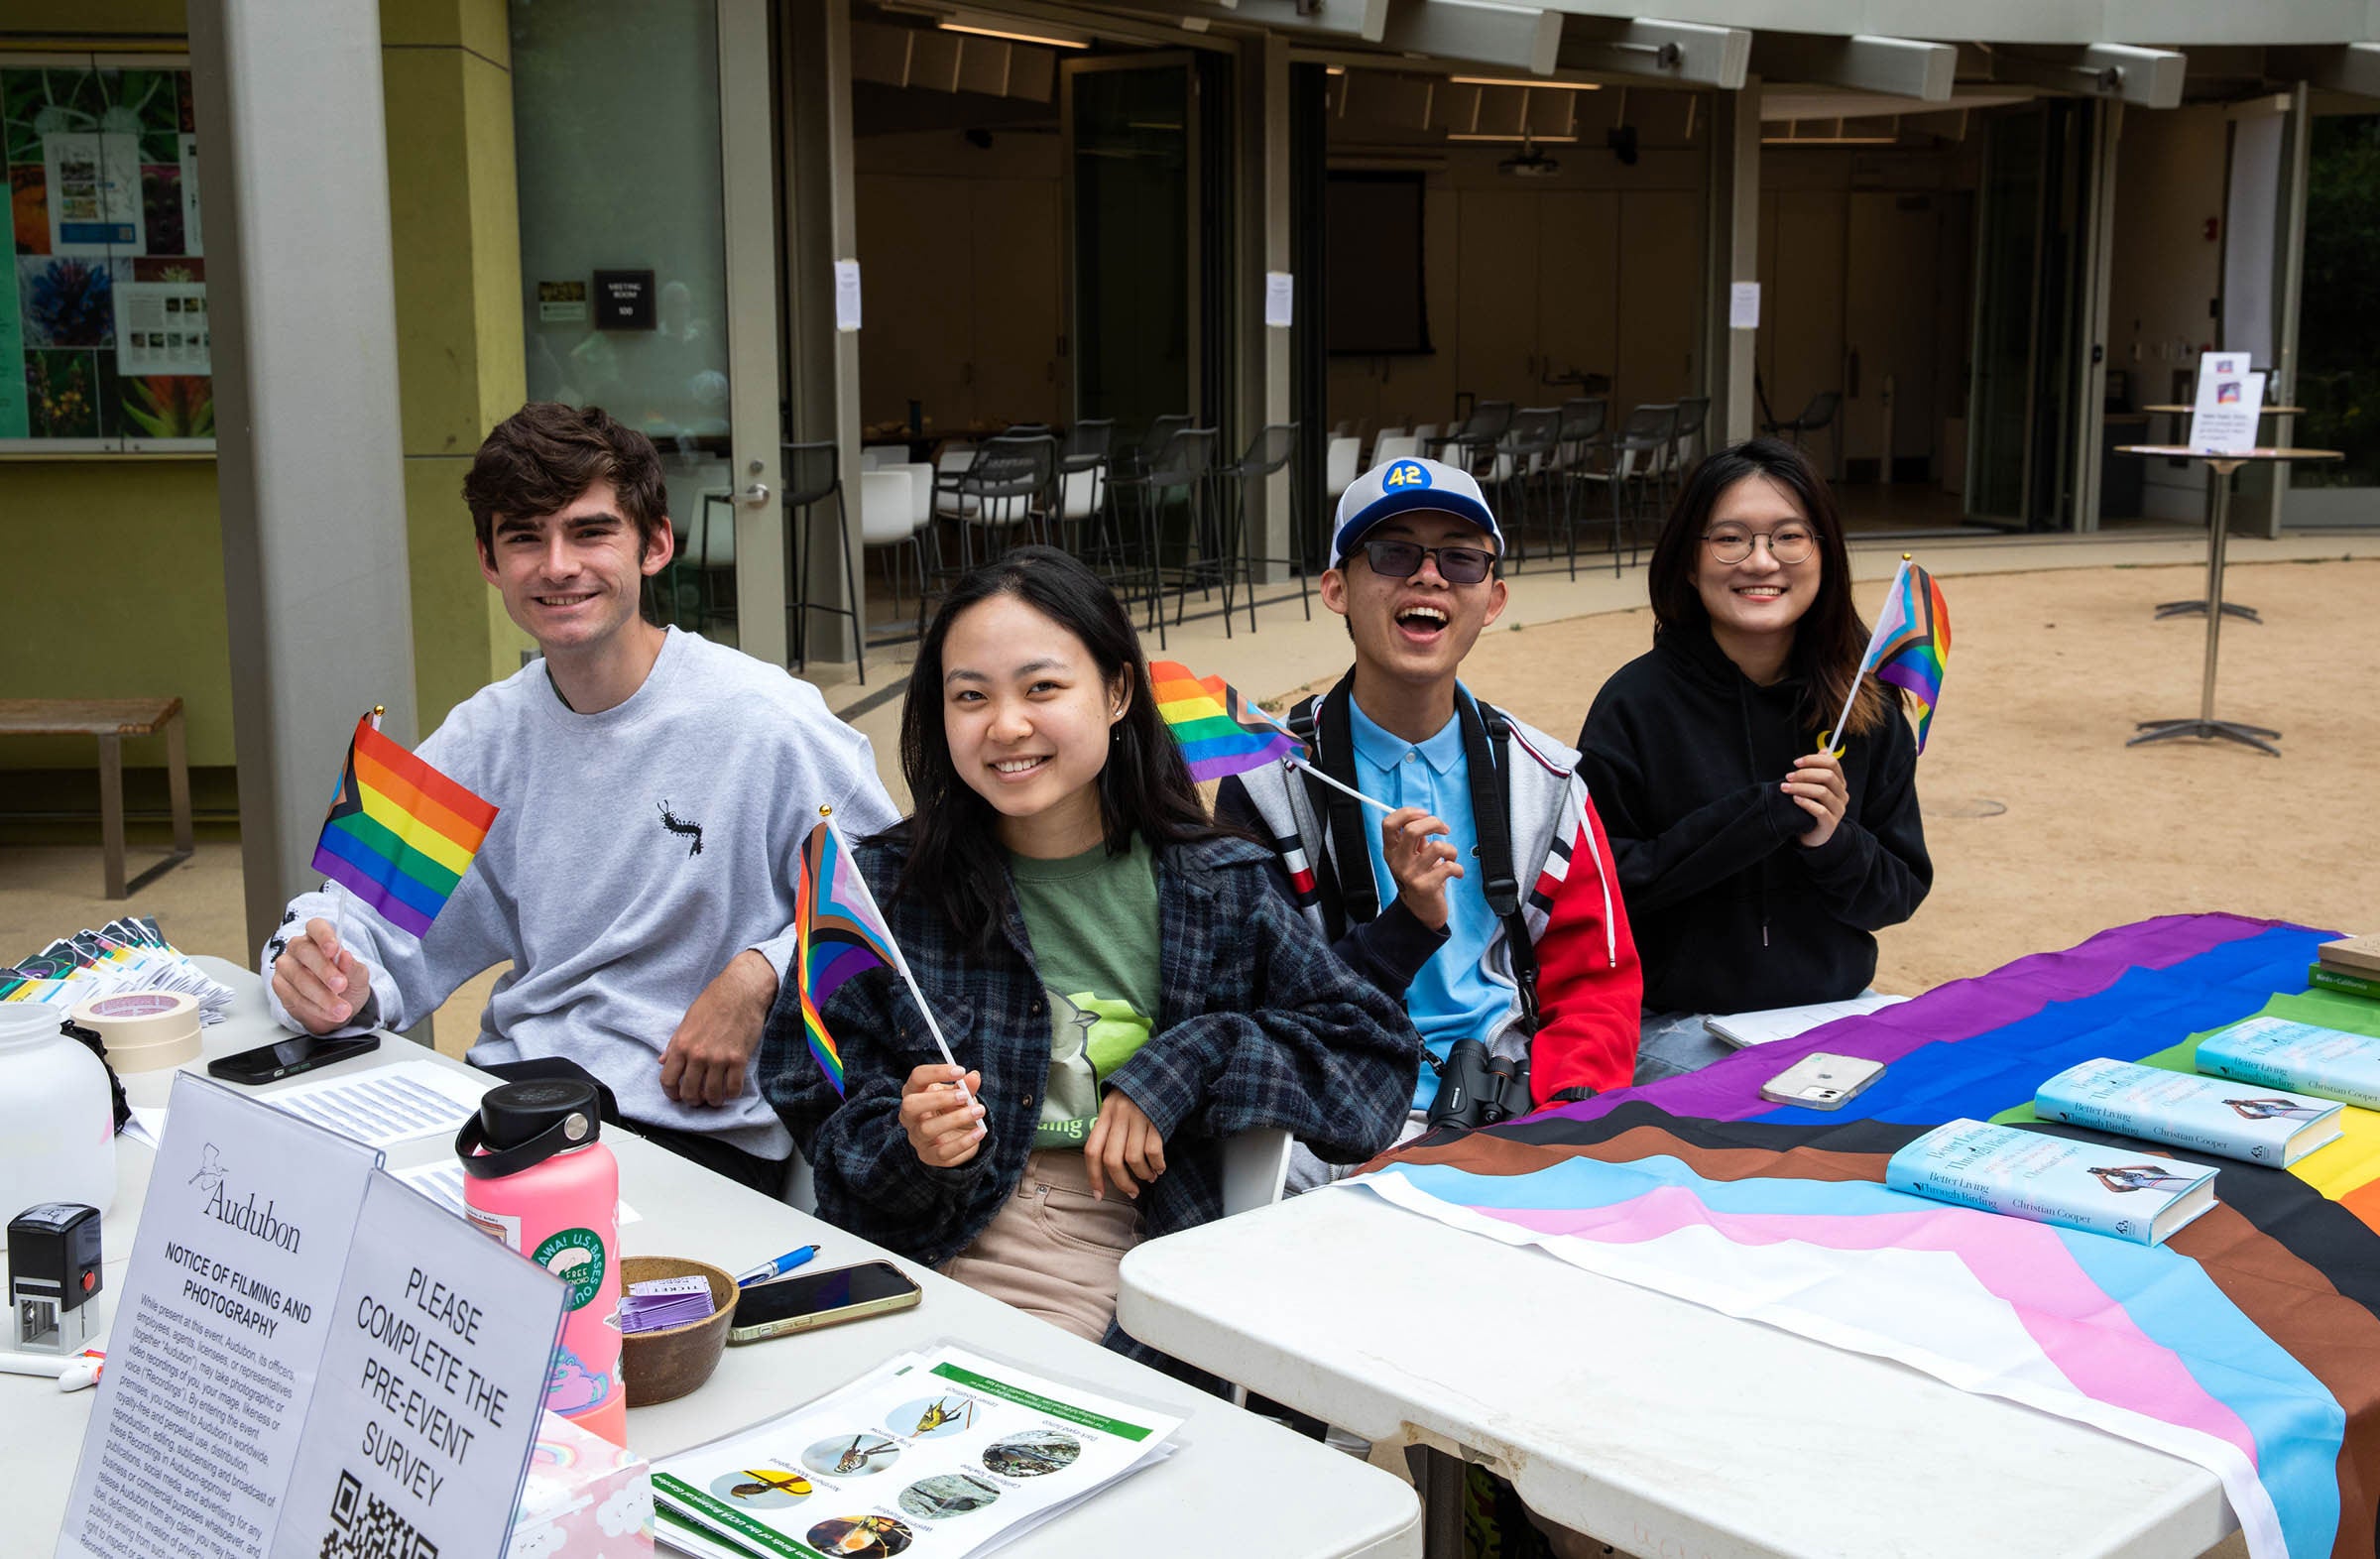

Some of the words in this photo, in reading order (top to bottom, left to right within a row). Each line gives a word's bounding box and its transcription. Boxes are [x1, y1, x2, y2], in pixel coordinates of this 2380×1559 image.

[1388, 466, 1422, 486] 42
[2317, 974, 2332, 983] Birds
[2234, 1057, 2260, 1070] Better
[2261, 1063, 2289, 1076] Living
[2227, 1067, 2262, 1082] Through
[2263, 1075, 2296, 1090] Birding
[2309, 1080, 2346, 1095] Christian
[2347, 1087, 2380, 1102] Cooper
[2075, 1102, 2101, 1117] Better
[2102, 1109, 2132, 1123] Living
[2067, 1112, 2104, 1128] Through
[2105, 1121, 2139, 1136] Birding
[2153, 1127, 2194, 1142] Christian
[2195, 1135, 2228, 1149] Cooper
[1930, 1171, 1958, 1187] Better
[1959, 1179, 1990, 1194] Living
[203, 1179, 301, 1254] Audubon
[1920, 1182, 1961, 1200] Through
[1962, 1192, 1998, 1209] Birding
[2012, 1198, 2056, 1216] Christian
[2057, 1207, 2091, 1224] Cooper
[565, 1267, 588, 1279] FREE
[590, 1244, 602, 1285] BASES
[165, 1241, 210, 1276] NOTICE
[211, 1262, 230, 1282] OF
[229, 1271, 281, 1309] FILMING
[282, 1291, 312, 1324] AND
[182, 1279, 279, 1339] PHOTOGRAPHY
[405, 1266, 483, 1346] PLEASE
[140, 1292, 158, 1311] While
[158, 1304, 183, 1323] present
[182, 1316, 191, 1328] at
[190, 1319, 203, 1334] this
[258, 1353, 267, 1366] its
[131, 1325, 161, 1349] (together
[199, 1362, 214, 1380] may
[213, 1369, 229, 1385] take
[229, 1378, 275, 1409] photographic
[275, 1401, 285, 1414] or
[357, 1295, 463, 1394] COMPLETE
[464, 1368, 509, 1429] THE
[128, 1343, 146, 1360] video
[145, 1352, 178, 1379] recordings
[178, 1370, 187, 1381] of
[200, 1382, 218, 1398] your
[241, 1401, 271, 1426] likeness
[271, 1419, 280, 1431] or
[230, 1360, 238, 1371] or
[238, 1364, 293, 1399] representatives
[945, 1386, 978, 1400] Goldfinch
[115, 1390, 151, 1417] royalty-free
[150, 1410, 165, 1424] and
[164, 1418, 195, 1442] perpetual
[123, 1359, 141, 1375] voice
[188, 1392, 198, 1409] By
[198, 1399, 226, 1424] entering
[225, 1413, 238, 1428] the
[238, 1421, 260, 1440] event
[149, 1391, 163, 1406] you
[163, 1398, 189, 1421] consent
[188, 1412, 196, 1425] to
[361, 1357, 475, 1466] PRE-EVENT
[977, 1396, 999, 1408] Lesser
[870, 1427, 895, 1441] Sparrow
[1042, 1419, 1066, 1431] Junco
[1062, 1425, 1099, 1442] Dark-eyed
[108, 1422, 127, 1441] these
[126, 1431, 161, 1462] Recordings
[161, 1453, 169, 1466] in
[177, 1444, 217, 1478] sublicensing
[216, 1468, 231, 1483] and
[230, 1474, 268, 1504] broadcast
[266, 1497, 276, 1508] of
[361, 1420, 444, 1506] SURVEY
[769, 1458, 811, 1480] Mockingbird
[960, 1464, 987, 1478] Towhee
[653, 1475, 682, 1493] Garden
[810, 1475, 841, 1493] Northern
[990, 1475, 1021, 1490] California
[97, 1472, 120, 1493] release
[119, 1484, 149, 1510] Audubon
[148, 1501, 165, 1520] from
[164, 1512, 176, 1530] any
[176, 1520, 194, 1539] claim
[194, 1532, 209, 1548] you
[209, 1541, 224, 1559] may
[101, 1454, 127, 1479] business
[127, 1472, 136, 1484] or
[136, 1477, 174, 1506] commercial
[171, 1499, 203, 1525] purposes
[246, 1543, 261, 1559] and
[143, 1462, 163, 1481] social
[183, 1487, 198, 1502] and
[198, 1496, 235, 1528] advertising
[235, 1515, 247, 1532] for
[247, 1524, 262, 1544] any
[681, 1490, 723, 1518] Botanical
[721, 1511, 747, 1527] UCLA
[873, 1504, 906, 1520] Bluebird
[746, 1523, 763, 1537] the
[907, 1517, 934, 1533] Western
[773, 1537, 794, 1553] Birds
